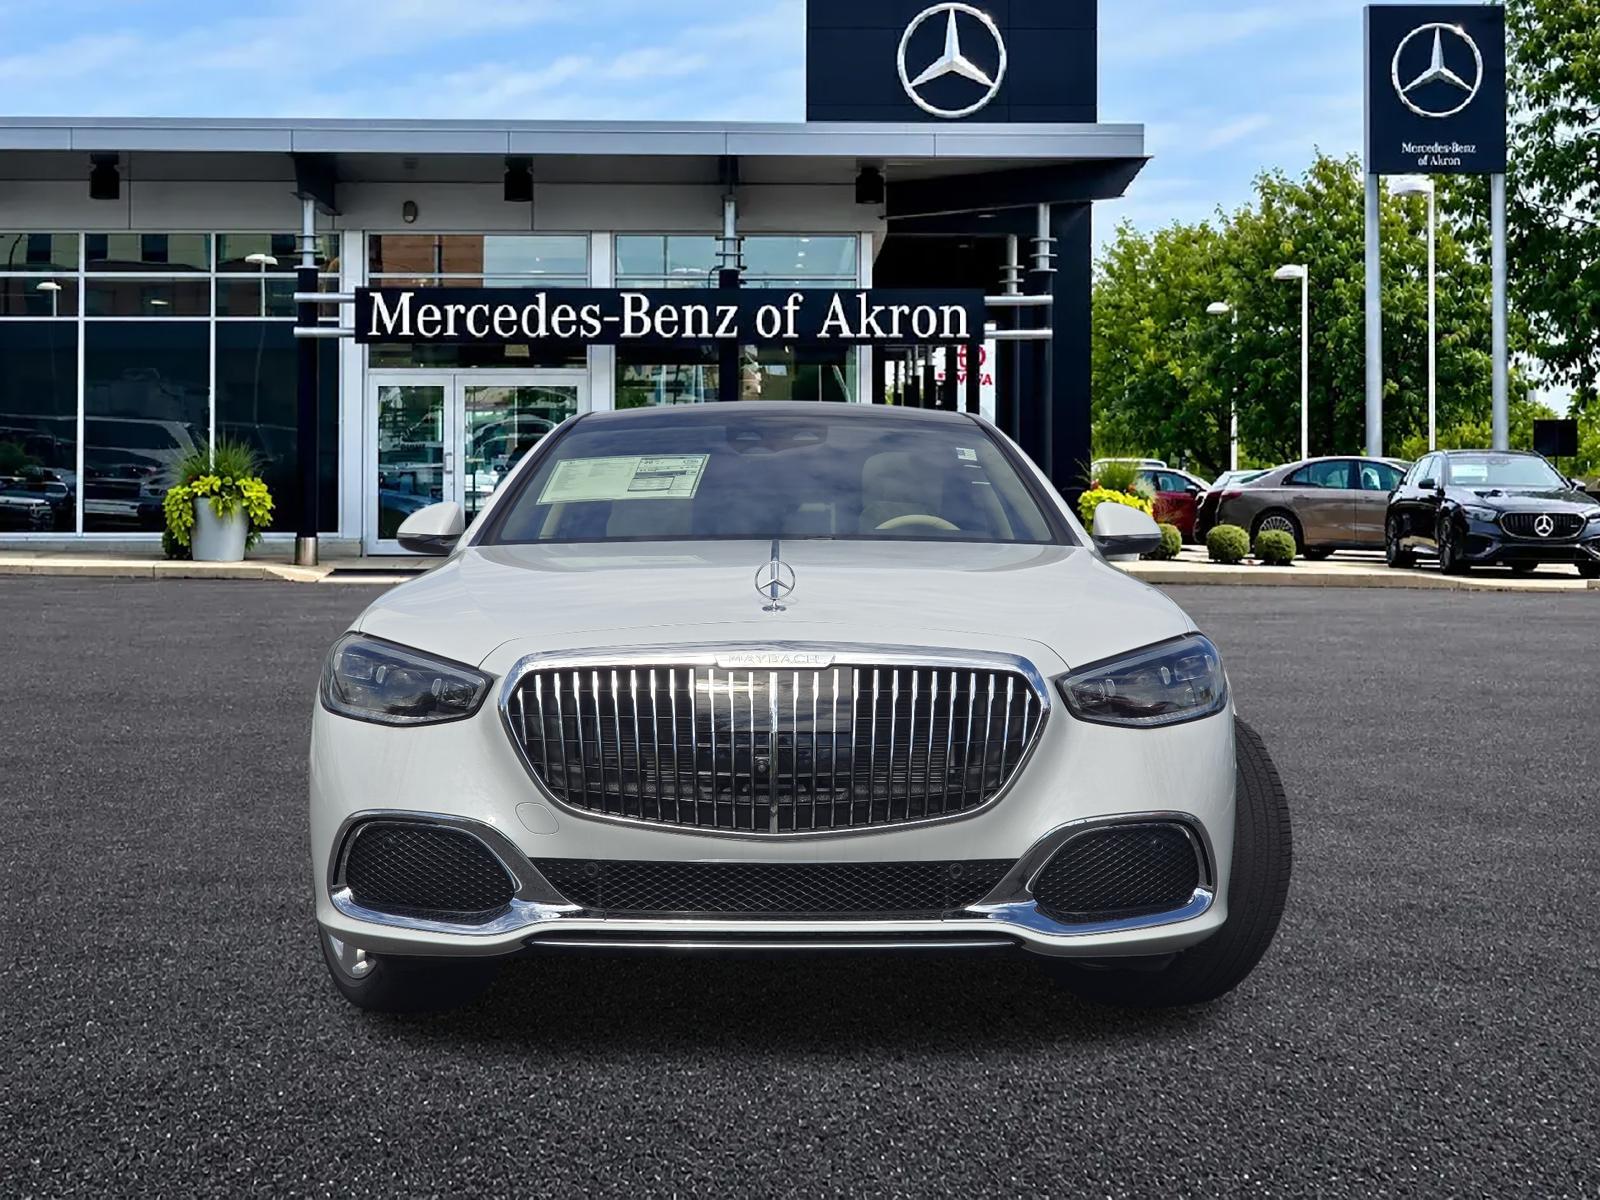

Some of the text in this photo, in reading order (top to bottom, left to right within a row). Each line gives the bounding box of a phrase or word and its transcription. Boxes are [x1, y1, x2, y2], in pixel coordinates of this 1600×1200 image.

[1401, 141, 1476, 154] Mercedes-Benz
[1417, 154, 1461, 166] of Akron
[367, 291, 970, 338] Mercedes-Benz of Akron
[728, 654, 820, 664] MAYBACH
